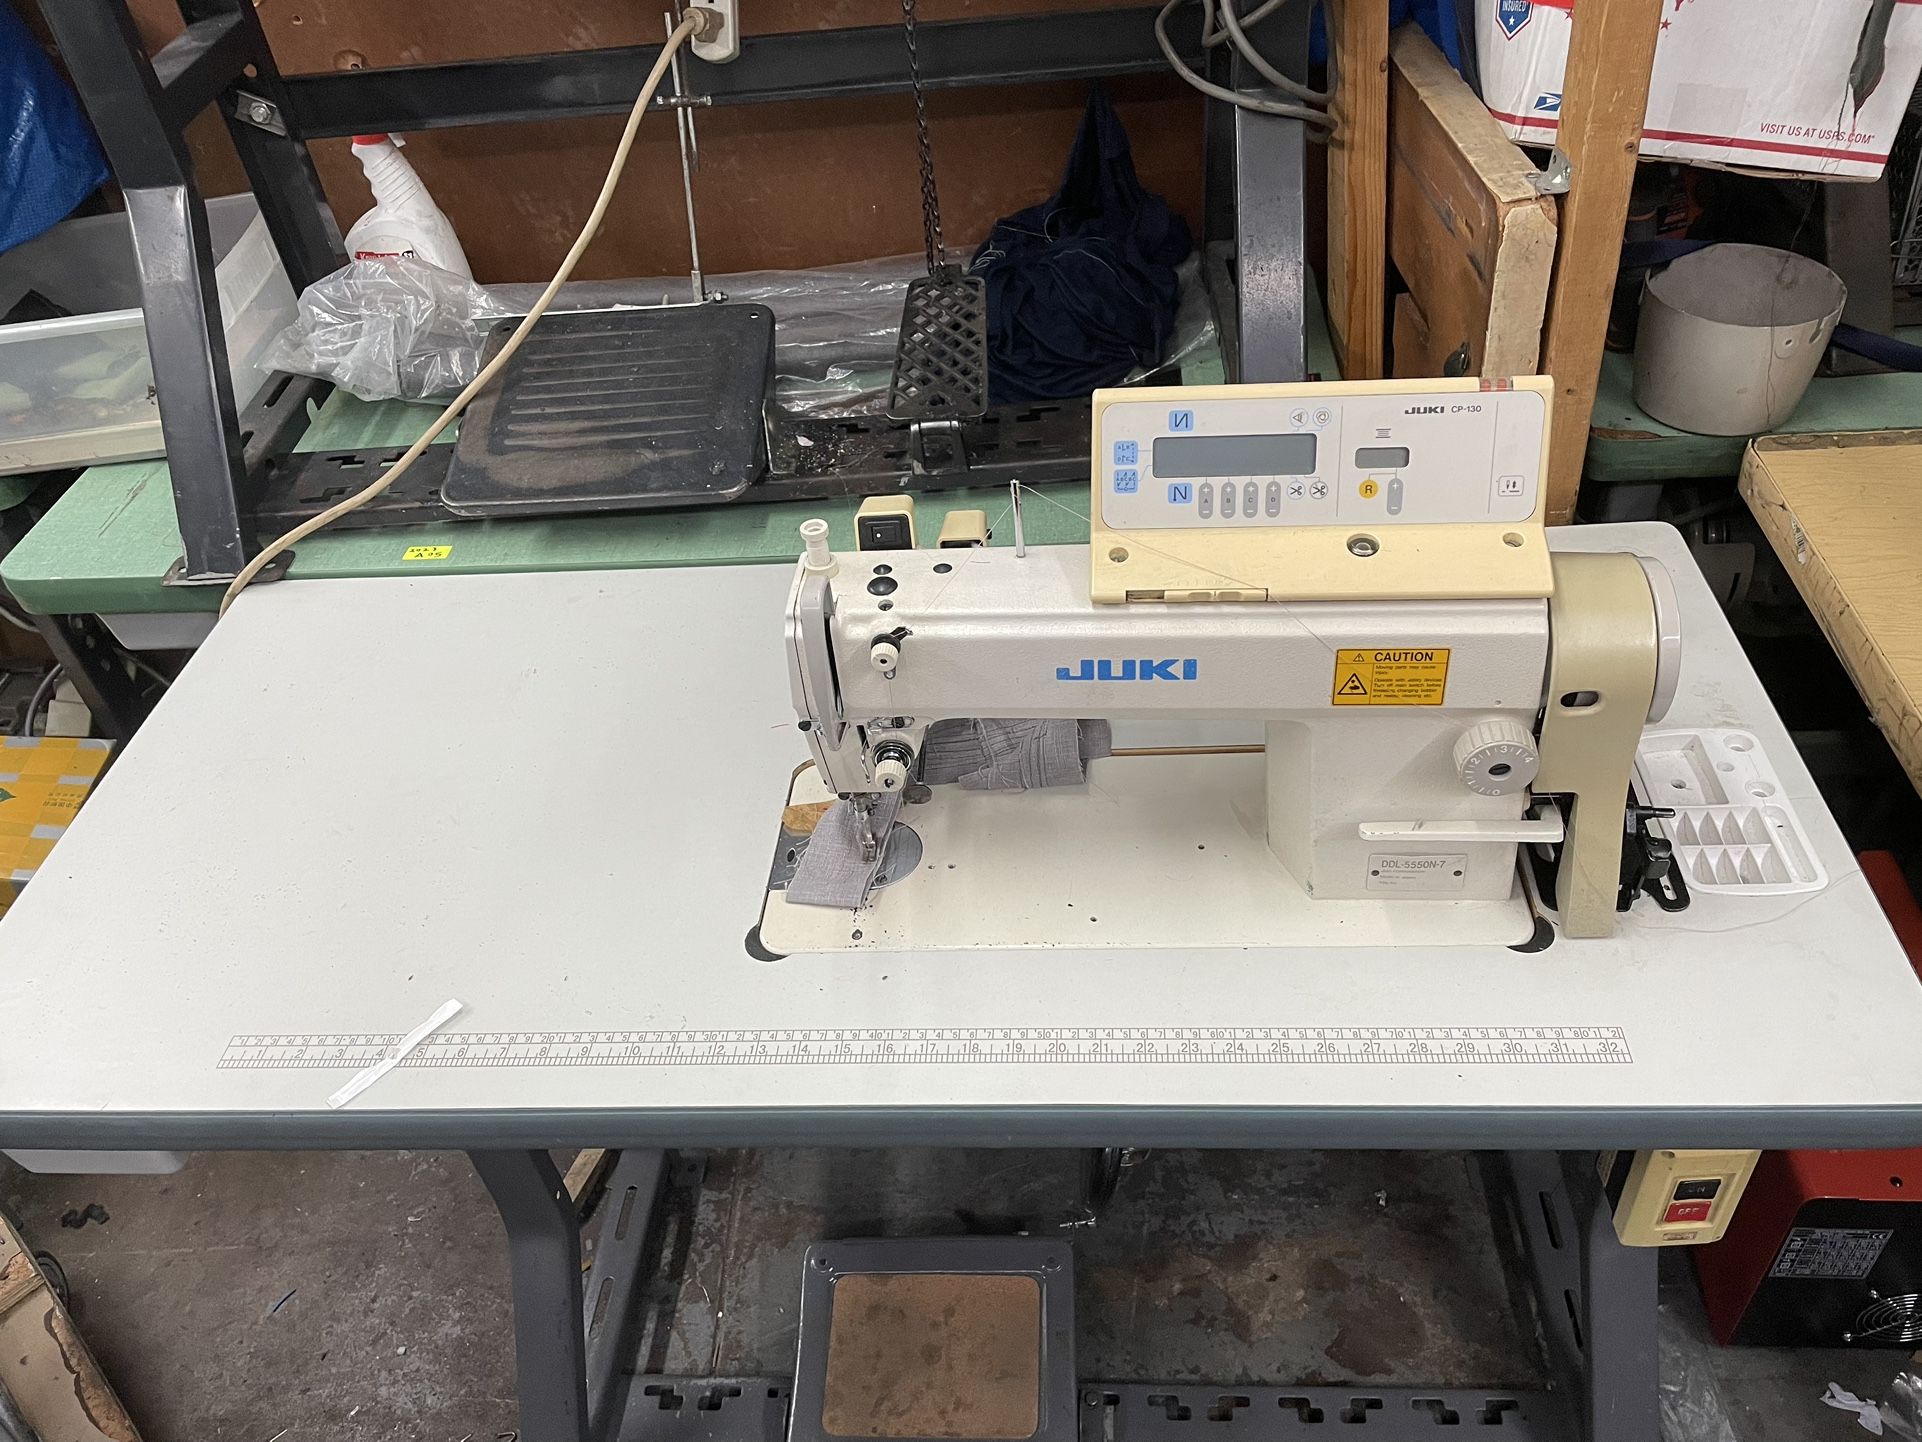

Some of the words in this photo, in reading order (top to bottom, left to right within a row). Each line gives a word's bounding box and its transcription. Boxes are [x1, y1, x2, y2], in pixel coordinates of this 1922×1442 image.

[1760, 122, 1786, 134] VISIT
[1788, 126, 1802, 136] US
[1803, 128, 1817, 138] AT
[1404, 406, 1445, 415] JUKI
[1451, 405, 1482, 413] CP-130
[1365, 484, 1373, 495] R
[1374, 652, 1434, 662] CAUTION
[1056, 658, 1197, 681] JUKI
[1381, 860, 1446, 869] DDL-5550N-7
[256, 1050, 262, 1059] 1
[294, 1050, 302, 1058] 2
[335, 1049, 343, 1058] 3
[376, 1049, 384, 1058] 4
[416, 1048, 425, 1057] 5
[457, 1048, 465, 1057] 6
[499, 1047, 506, 1056] 7
[539, 1047, 547, 1056] 8
[581, 1047, 589, 1056] 9
[1678, 1208, 1700, 1216] OFF
